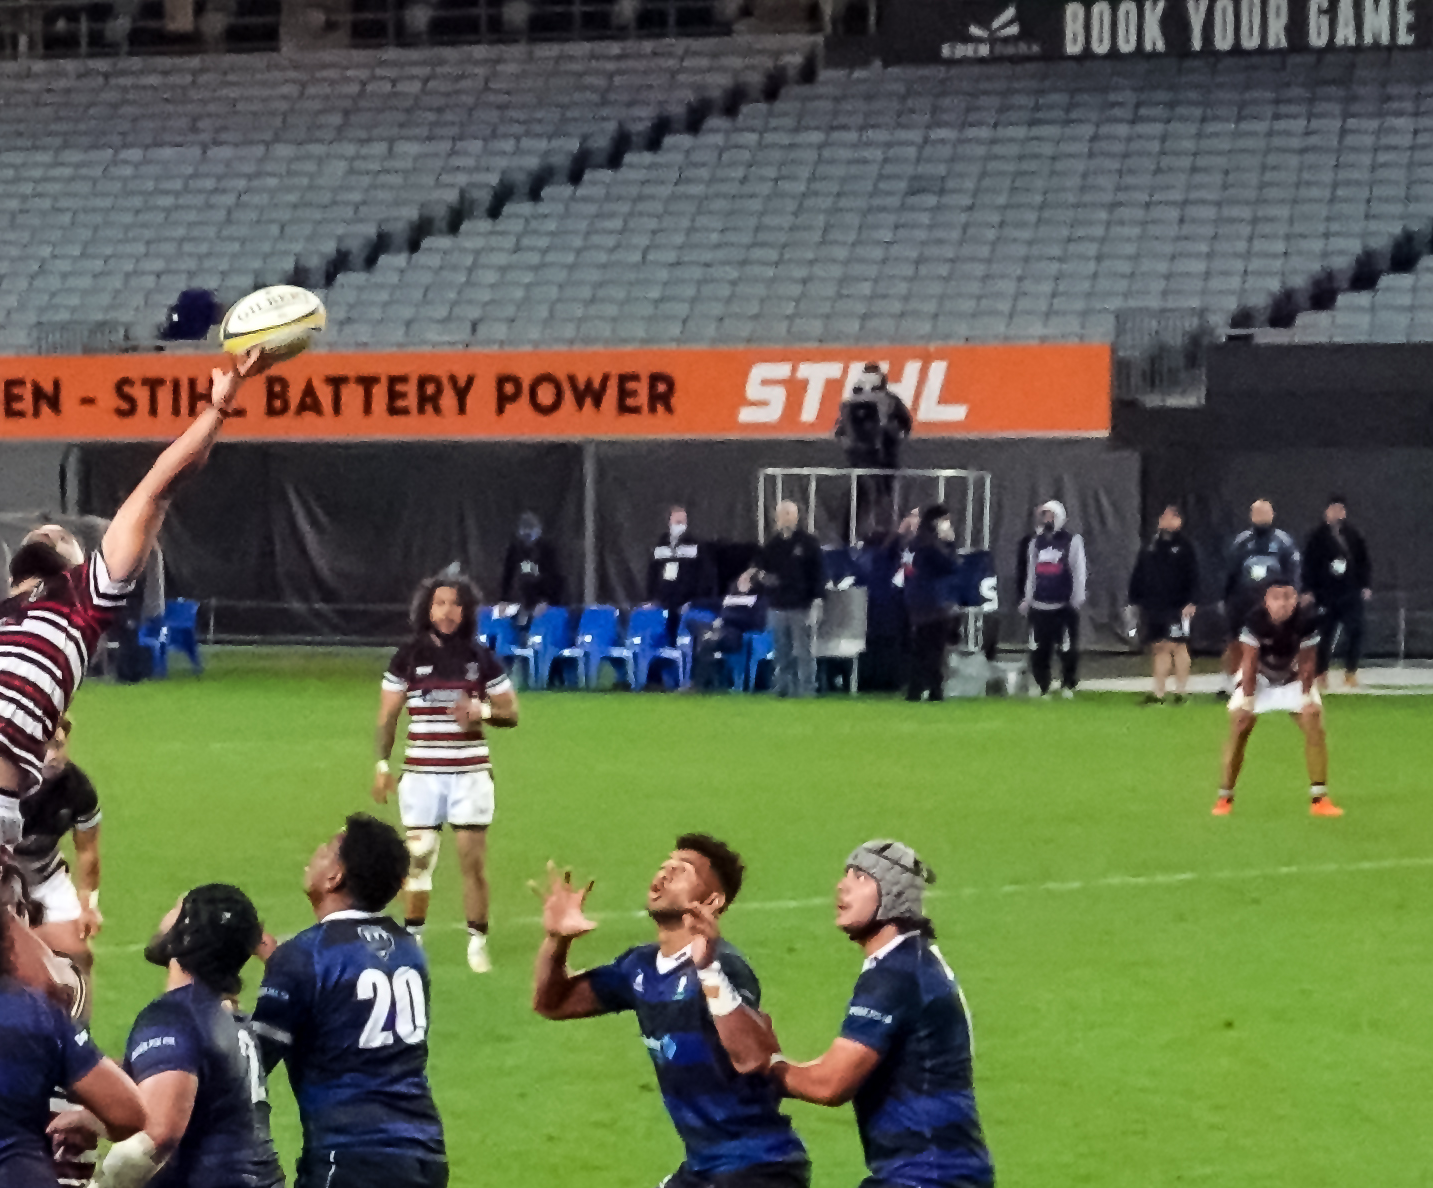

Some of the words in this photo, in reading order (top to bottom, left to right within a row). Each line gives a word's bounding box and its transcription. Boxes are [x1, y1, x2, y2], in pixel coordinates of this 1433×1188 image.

[1064, 0, 1165, 56] BOOK
[1187, 0, 1287, 52] YOUR
[1308, 0, 1415, 49] GAME
[264, 373, 476, 418] BATTERY
[495, 372, 677, 416] POWER
[357, 966, 427, 1050] 20
